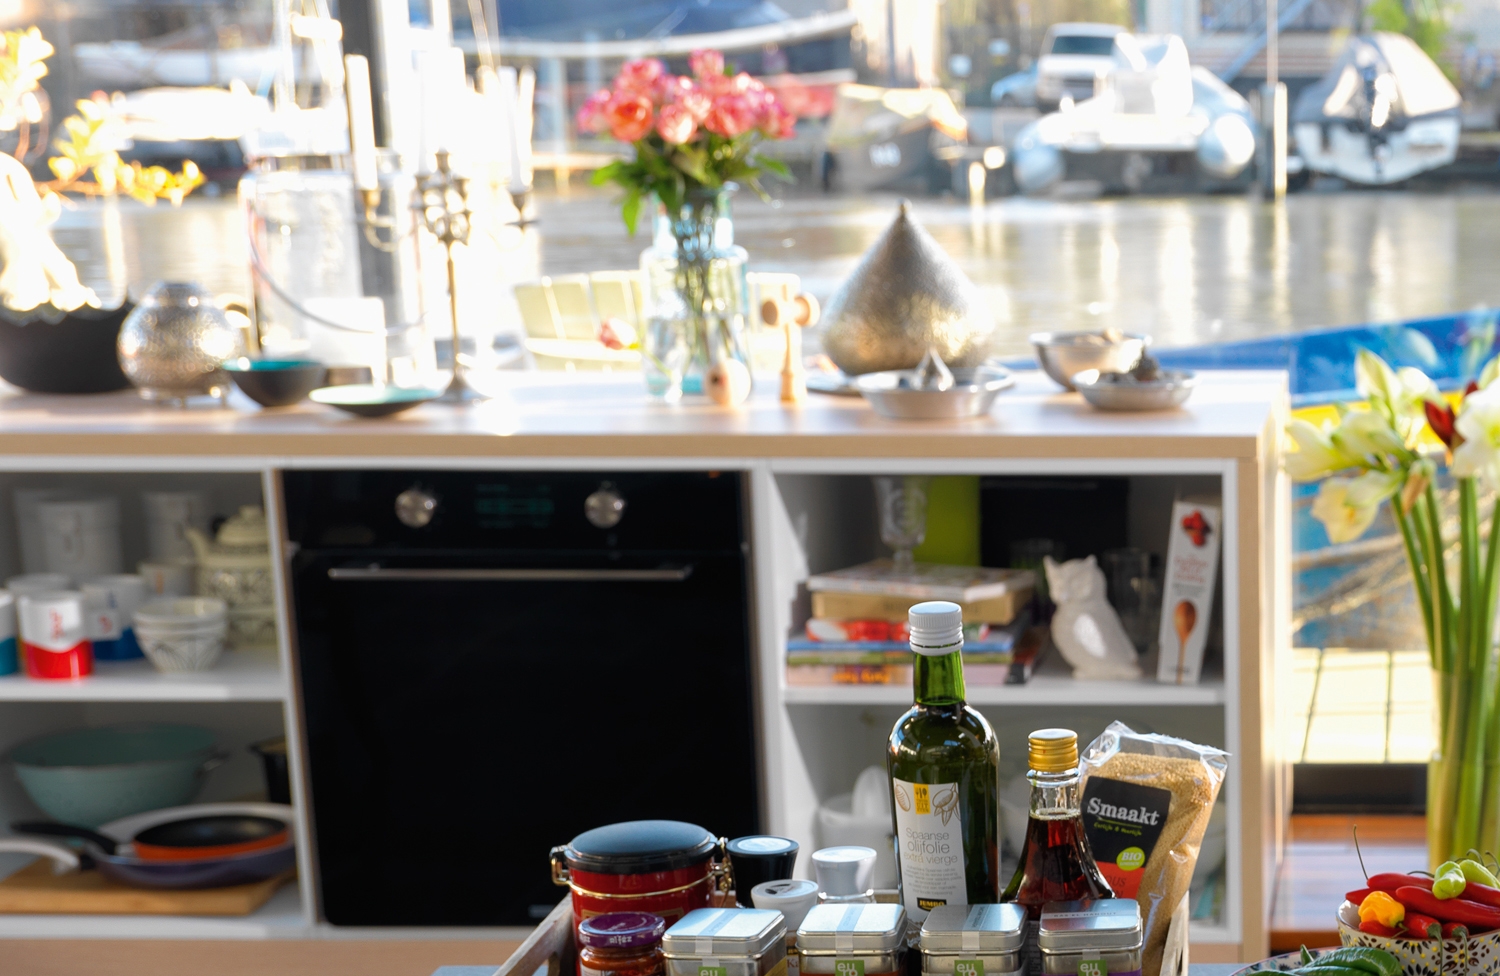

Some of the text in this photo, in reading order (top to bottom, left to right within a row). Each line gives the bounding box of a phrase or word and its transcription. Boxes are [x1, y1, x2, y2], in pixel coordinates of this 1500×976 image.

[1087, 797, 1160, 826] Smaakt
[906, 827, 949, 841] Spaanse
[907, 840, 950, 855] olijfolie
[904, 852, 958, 866] extra vierge
[1122, 852, 1142, 860] BIO
